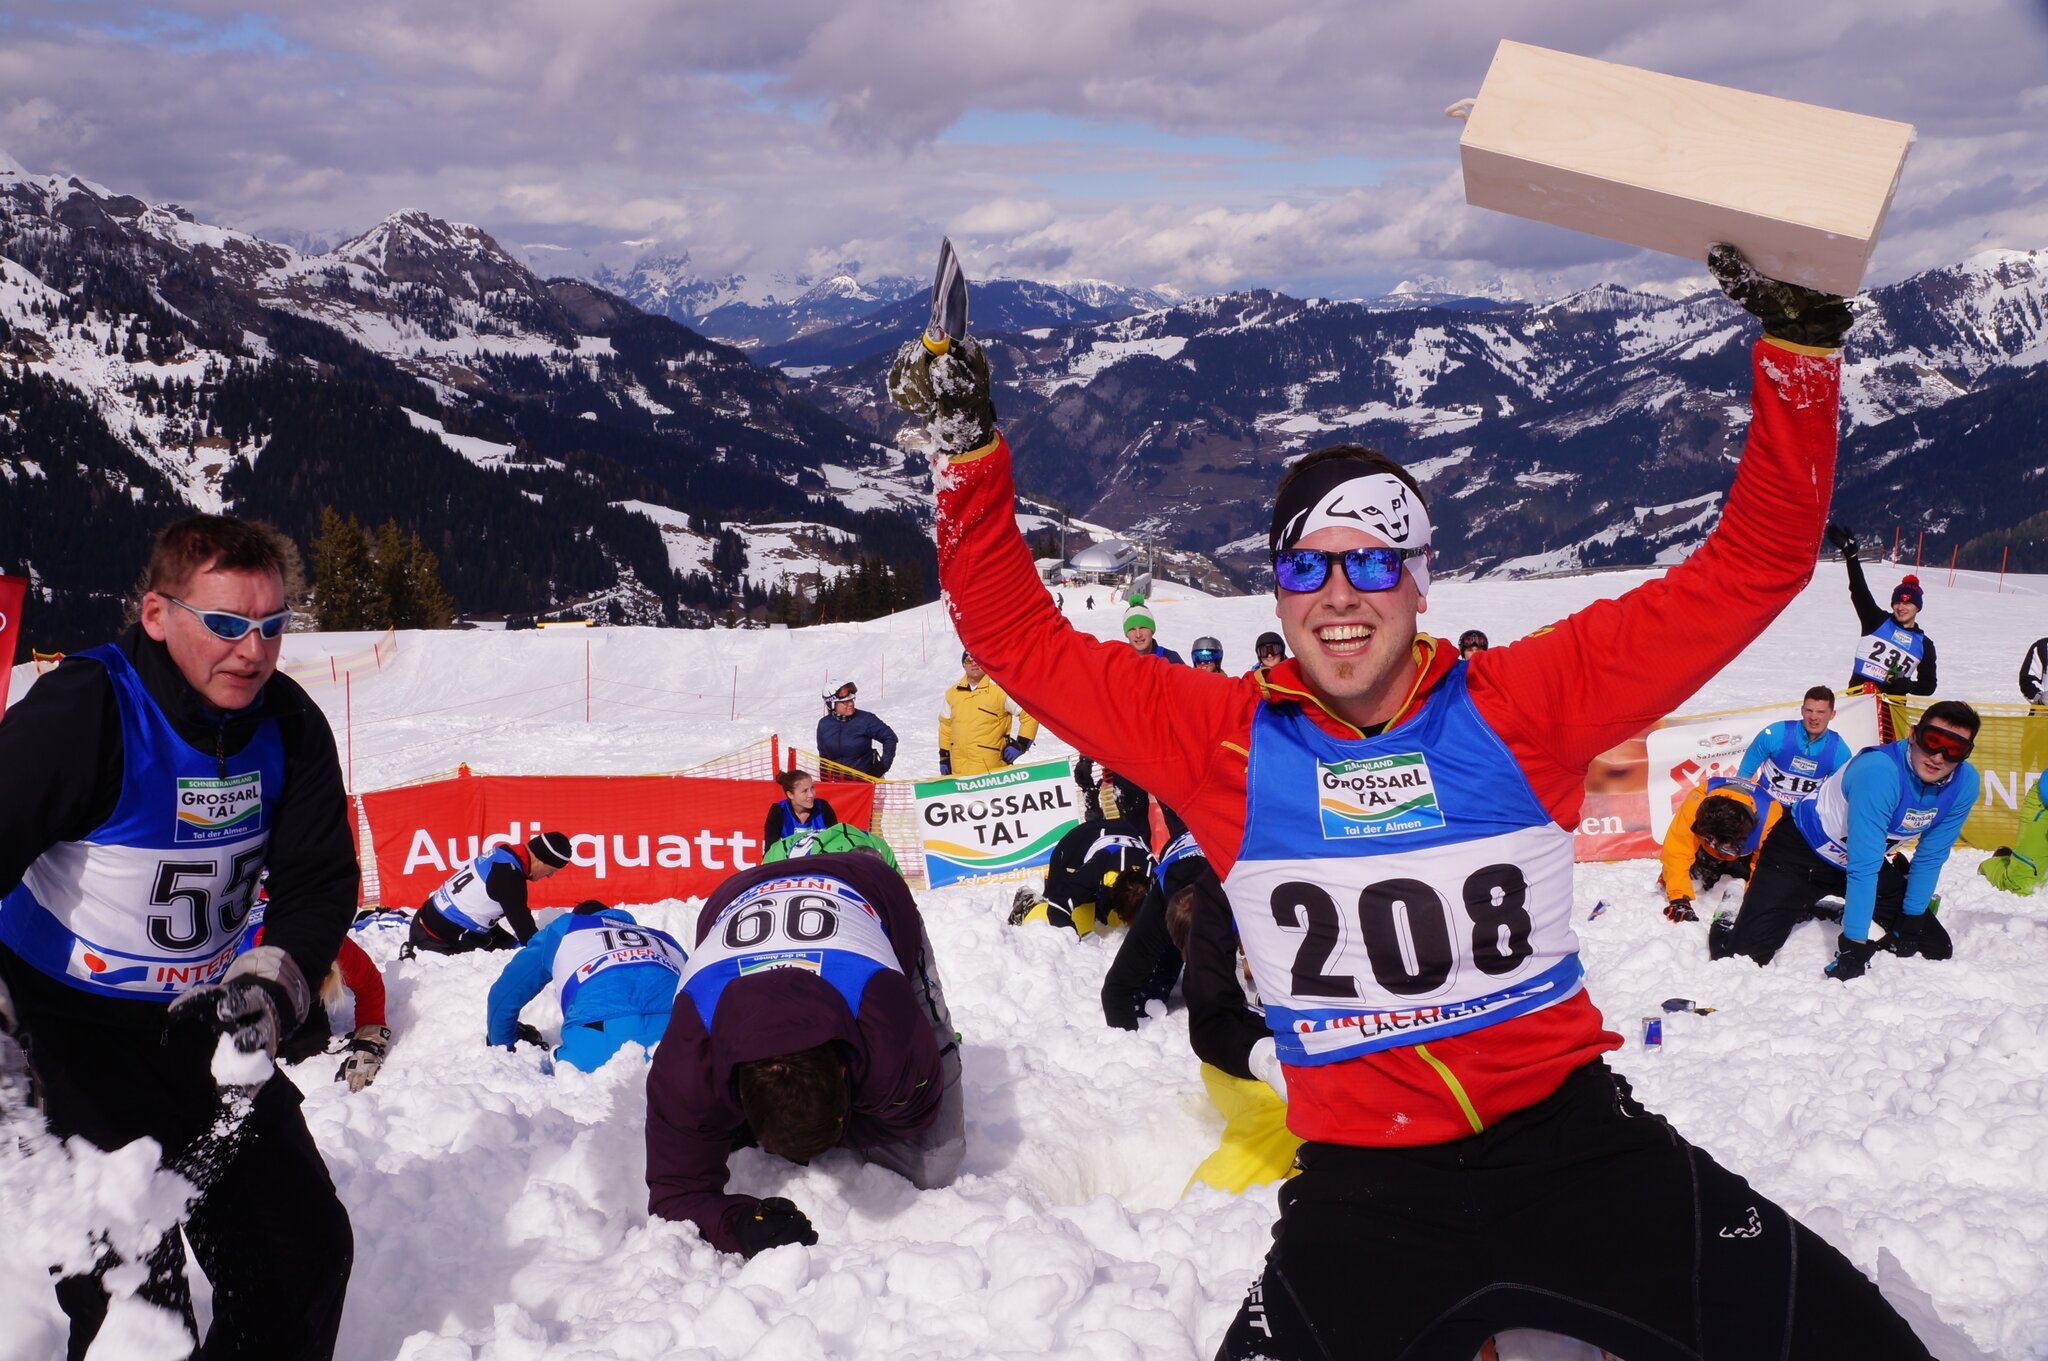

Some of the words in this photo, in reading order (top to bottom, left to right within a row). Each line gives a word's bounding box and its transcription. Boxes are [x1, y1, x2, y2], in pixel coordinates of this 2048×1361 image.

[1868, 641, 1914, 675] 235
[189, 776, 253, 788] SCHNEETRAUMLAND
[955, 771, 1030, 792] TRAUMLAND
[1322, 769, 1427, 791] GROSSARL
[181, 785, 259, 806] GROSSARL
[924, 785, 1072, 827] GROSSARL
[1356, 791, 1397, 807] TAL
[208, 805, 236, 819] TAL
[193, 832, 205, 840] Tal
[223, 826, 248, 836] Almen
[973, 820, 1028, 846] TAL
[1344, 826, 1360, 835] Tal
[1363, 823, 1382, 833] der
[1386, 820, 1422, 832] Almen
[1573, 815, 1626, 836] en
[570, 828, 767, 879] quatt
[147, 845, 264, 953] 55
[1270, 862, 1535, 1002] 208
